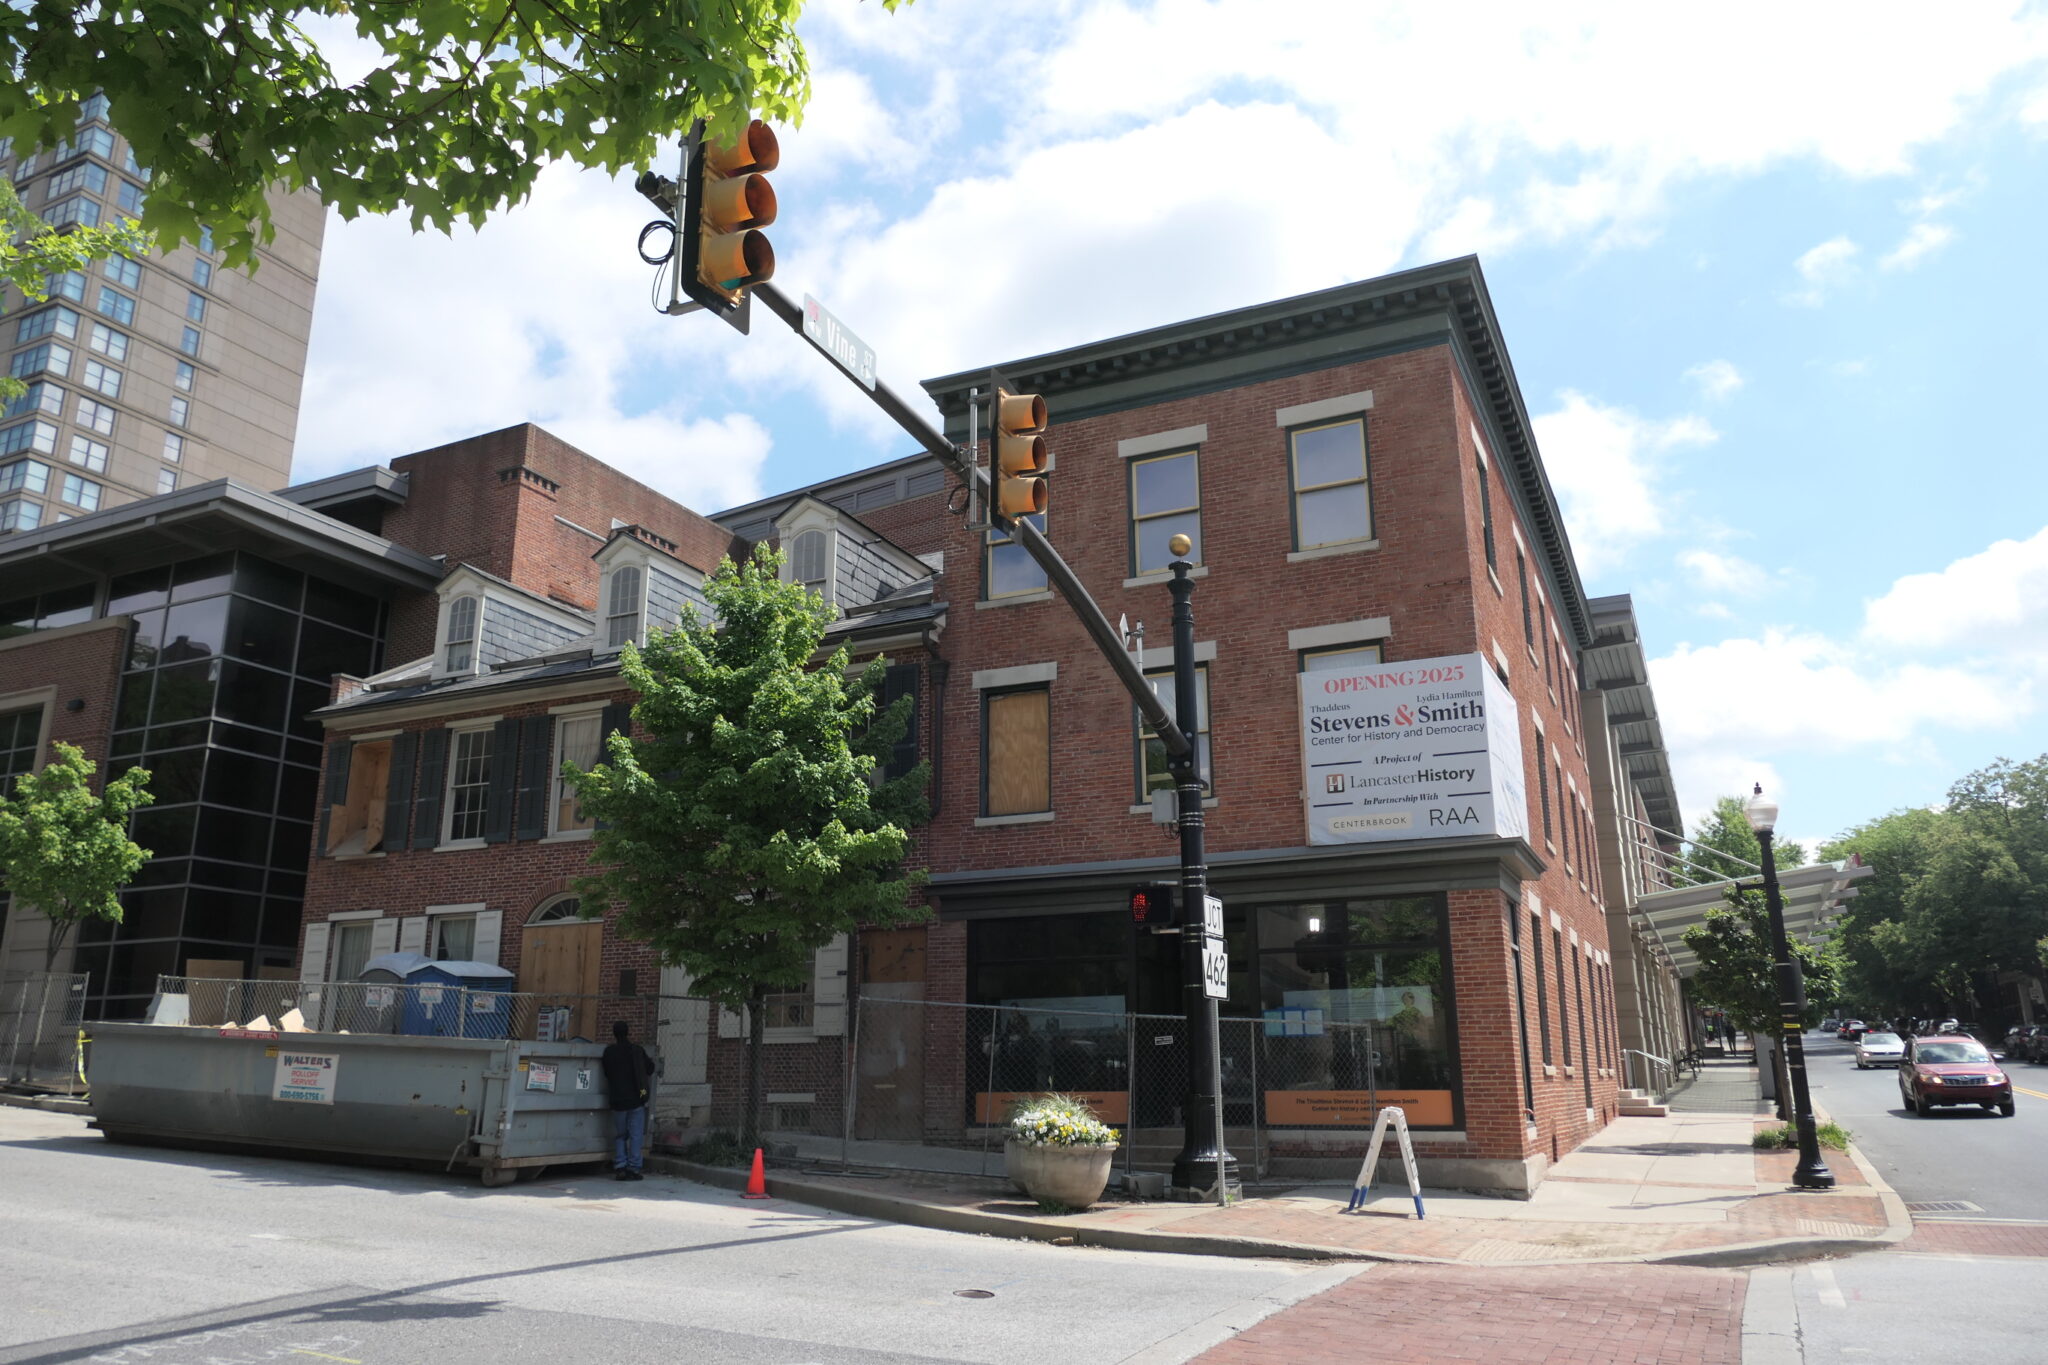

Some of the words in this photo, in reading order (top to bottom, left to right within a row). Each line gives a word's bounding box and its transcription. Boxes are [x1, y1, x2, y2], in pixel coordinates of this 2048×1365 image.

[826, 317, 856, 368] Vine
[1324, 672, 1413, 694] OPENING
[1417, 665, 1465, 684] 2025
[1416, 693, 1440, 703] Lydia
[1442, 690, 1483, 701] Hamilton
[1310, 704, 1351, 713] Thaddeus
[1310, 713, 1391, 733] Stevens
[1394, 704, 1415, 726] &
[1418, 700, 1484, 723] Smith
[1311, 734, 1345, 746] Center
[1347, 733, 1361, 743] for
[1364, 730, 1401, 741] History
[1403, 727, 1423, 738] and
[1426, 722, 1485, 736] Democracy
[1373, 756, 1379, 765] A
[1380, 754, 1411, 765] Project
[1412, 752, 1423, 762] of
[1350, 768, 1475, 789] LancasterHistory
[1364, 798, 1372, 806] In
[1373, 795, 1418, 805] Partnership
[1419, 793, 1439, 802] With
[1333, 816, 1407, 829] CENTERBROOK
[1429, 806, 1480, 826] RAA
[1207, 904, 1221, 931] JCT
[1206, 952, 1226, 987] 462
[284, 1055, 332, 1069] WALTERS
[291, 1070, 320, 1078] ROLLOFF
[291, 1078, 318, 1086] SERVICE
